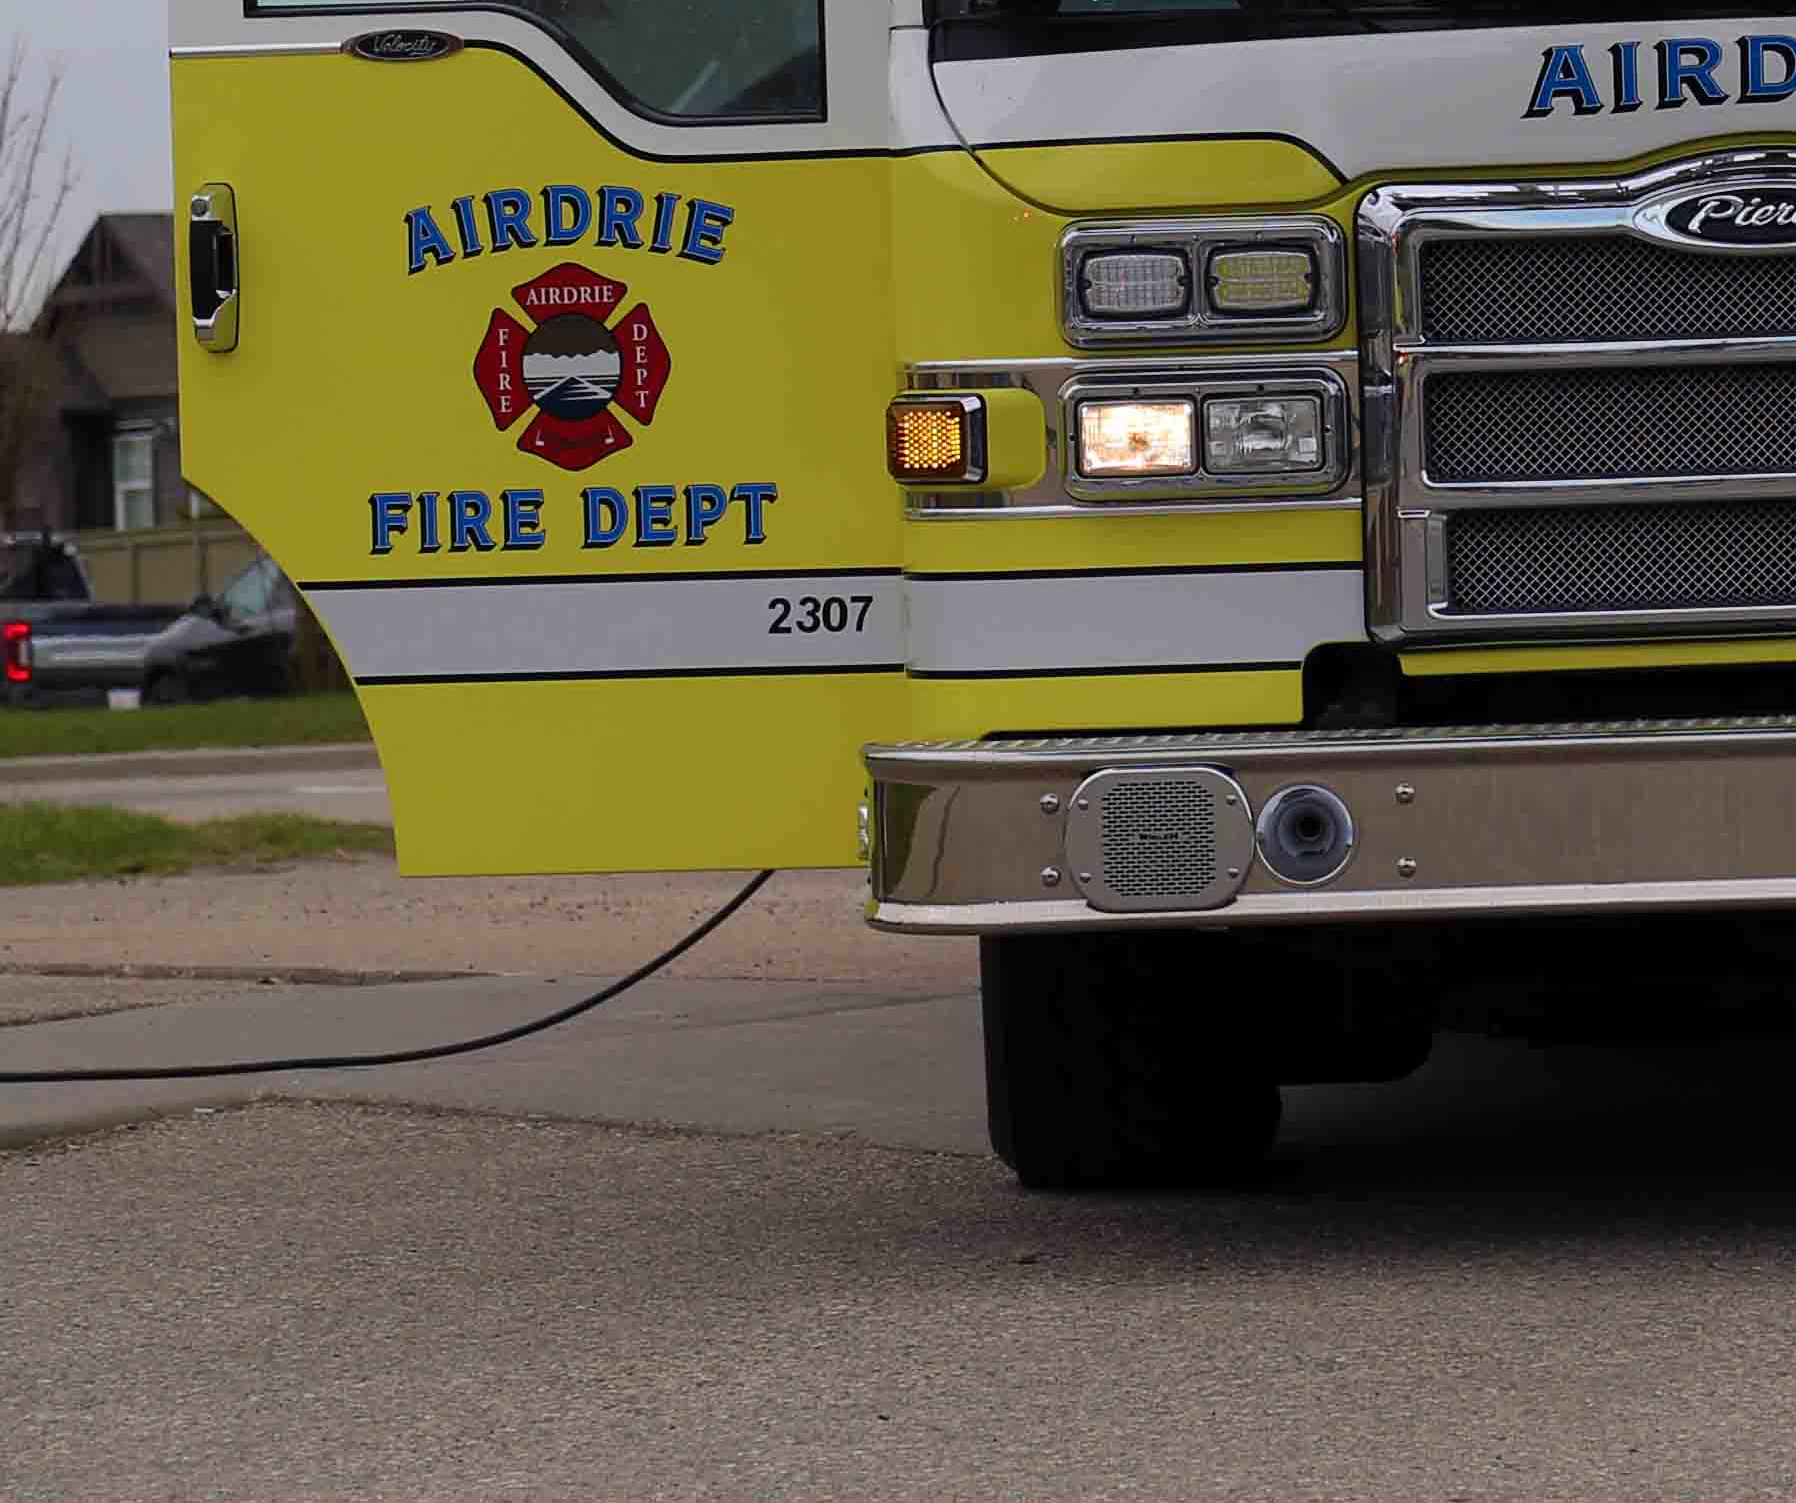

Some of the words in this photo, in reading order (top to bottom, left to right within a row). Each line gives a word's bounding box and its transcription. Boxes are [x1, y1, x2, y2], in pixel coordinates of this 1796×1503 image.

[403, 184, 736, 276] AIRDRIE
[526, 285, 615, 306] AIRDRIE
[498, 328, 512, 413] FIRE
[632, 324, 649, 408] DEPT
[368, 487, 547, 555] FIRE
[580, 482, 778, 550] DEPT
[767, 595, 874, 635] 2307
